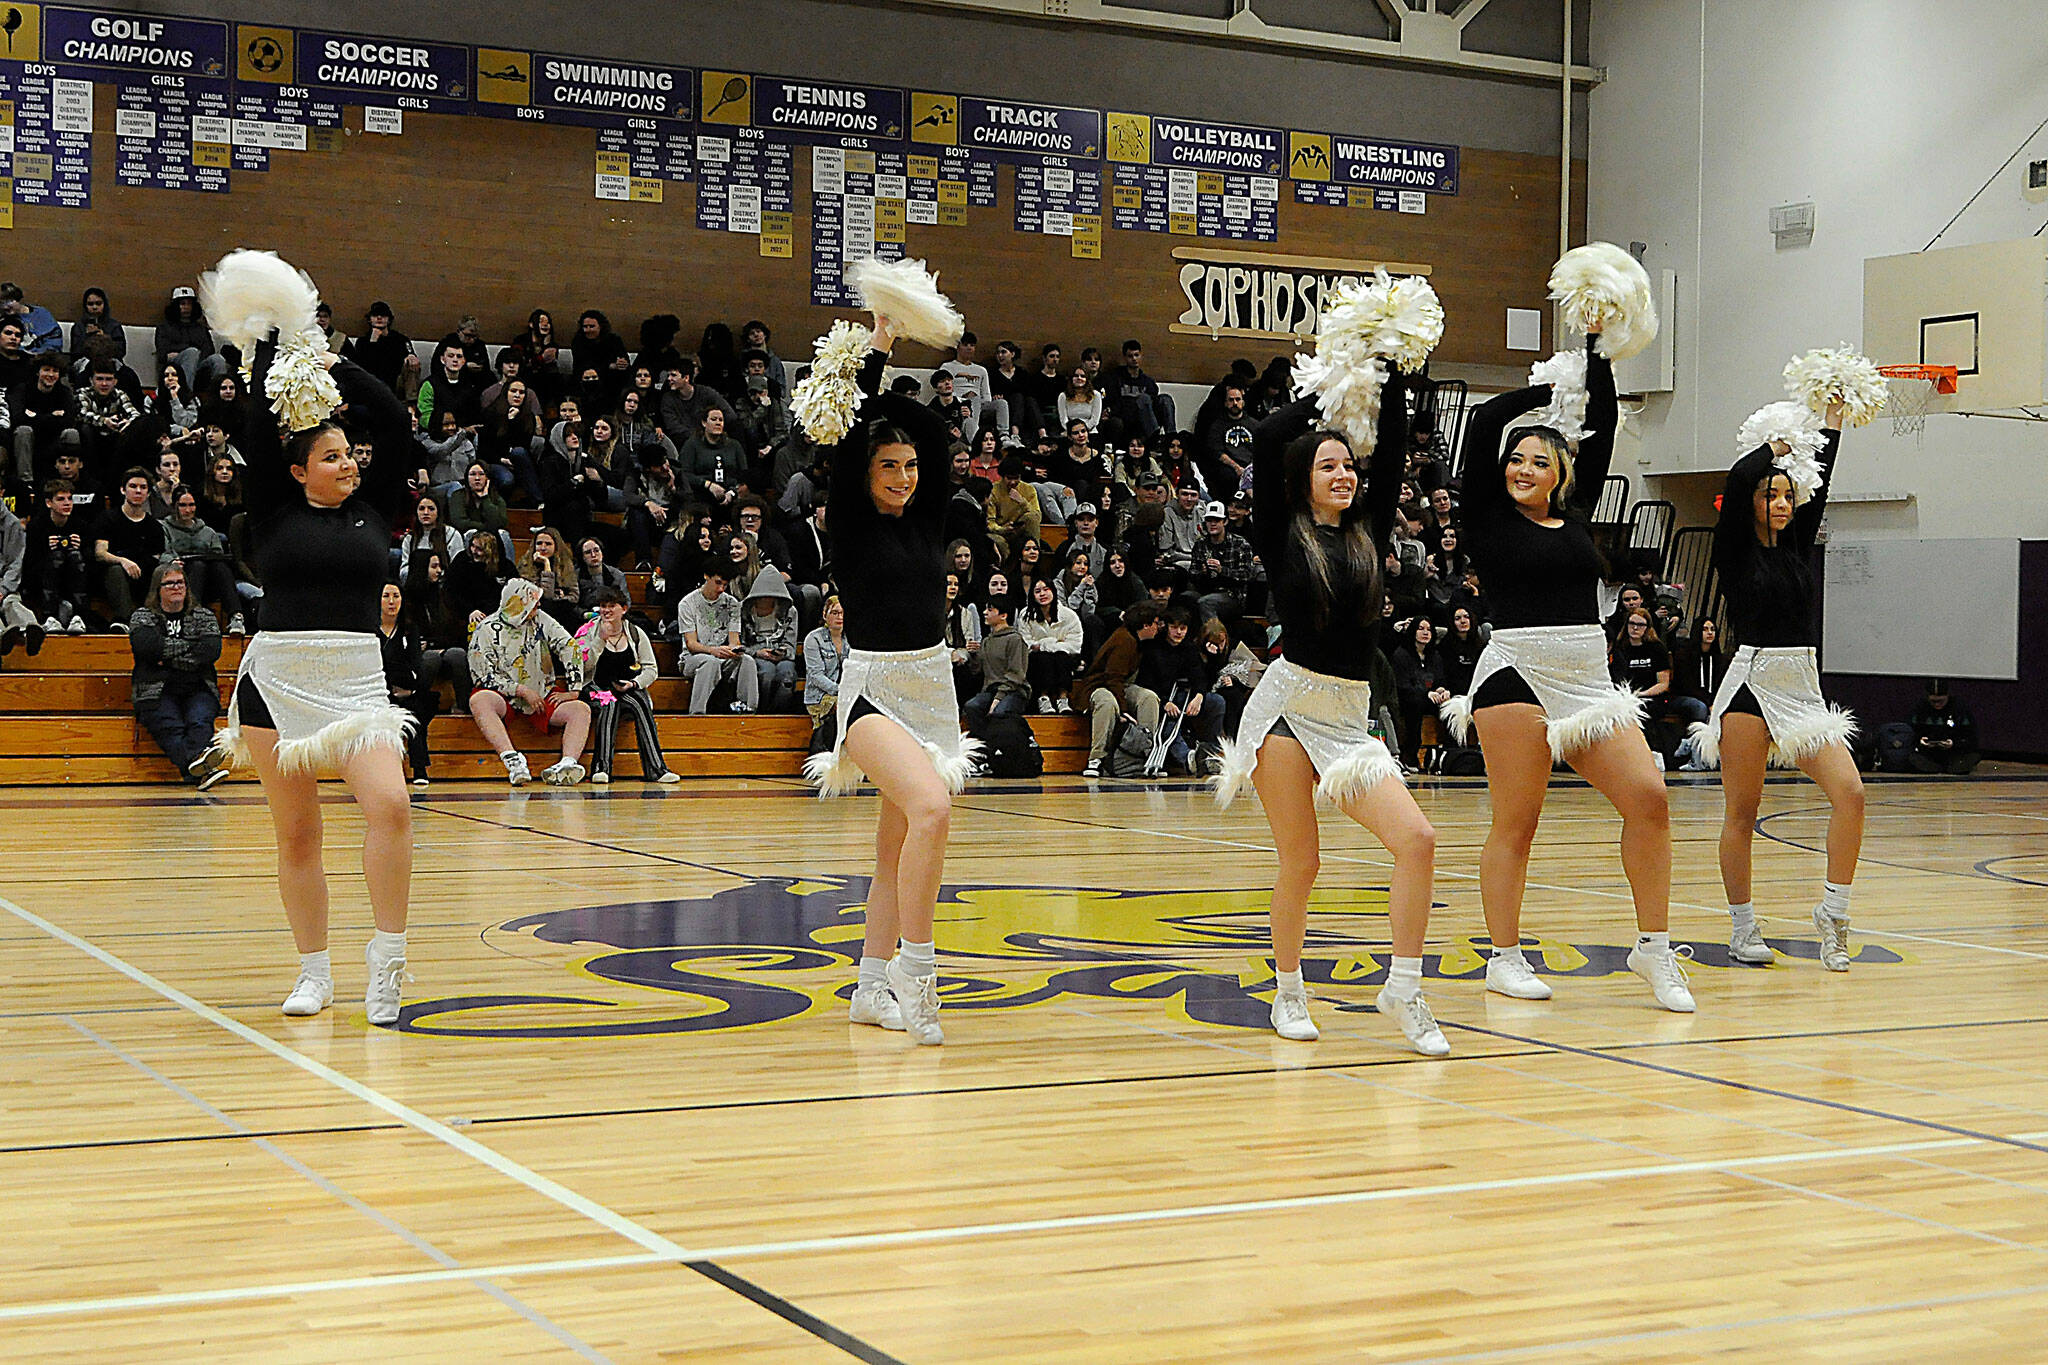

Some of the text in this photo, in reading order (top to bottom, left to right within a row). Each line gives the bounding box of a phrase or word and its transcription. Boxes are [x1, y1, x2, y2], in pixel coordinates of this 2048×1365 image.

[91, 17, 164, 42] GOLF
[64, 40, 194, 68] CHAMPIONS
[324, 40, 430, 68] SOCCER
[24, 63, 56, 76] BOYS
[151, 75, 185, 87] GIRLS
[318, 64, 439, 91] CHAMPIONS
[545, 61, 673, 91] SWIMMING
[18, 86, 49, 94] CHAMPION
[279, 86, 309, 99] BOYS
[121, 94, 152, 102] CHAMPION
[397, 96, 429, 109] GIRLS
[554, 86, 667, 112] CHAMPIONS
[782, 85, 866, 109] TENNIS
[22, 103, 45, 111] LEAGUE
[197, 101, 227, 109] CHAMPION
[237, 104, 266, 112] CHAMPION
[18, 111, 49, 119] CHAMPION
[371, 109, 396, 117] DISTRICT
[517, 107, 545, 119] BOYS
[986, 105, 1059, 129] TRACK
[121, 118, 151, 126] CHAMPION
[369, 116, 398, 124] CHAMPION
[627, 118, 657, 130] GIRLS
[772, 107, 878, 131] CHAMPIONS
[739, 128, 765, 140] BOYS
[973, 126, 1072, 150] CHAMPIONS
[1157, 124, 1277, 151] VOLLEYBALL
[56, 140, 88, 148] CHAMPION
[633, 139, 659, 147] CHAMPION
[666, 142, 692, 150] CHAMPION
[840, 137, 868, 148] GIRLS
[120, 145, 152, 153] CHAMPION
[945, 147, 970, 158] BOYS
[236, 154, 266, 162] CHAMPION
[1172, 146, 1263, 169] CHAMPIONS
[1336, 142, 1446, 169] WRESTLING
[1042, 156, 1068, 167] GIRLS
[119, 170, 151, 178] CHAMPION
[764, 173, 789, 181] CHAMPION
[1349, 164, 1436, 186] CHAMPIONS
[20, 180, 44, 188] LEAGUE
[16, 187, 48, 195] CHAMPION
[56, 190, 87, 198] CHAMPION
